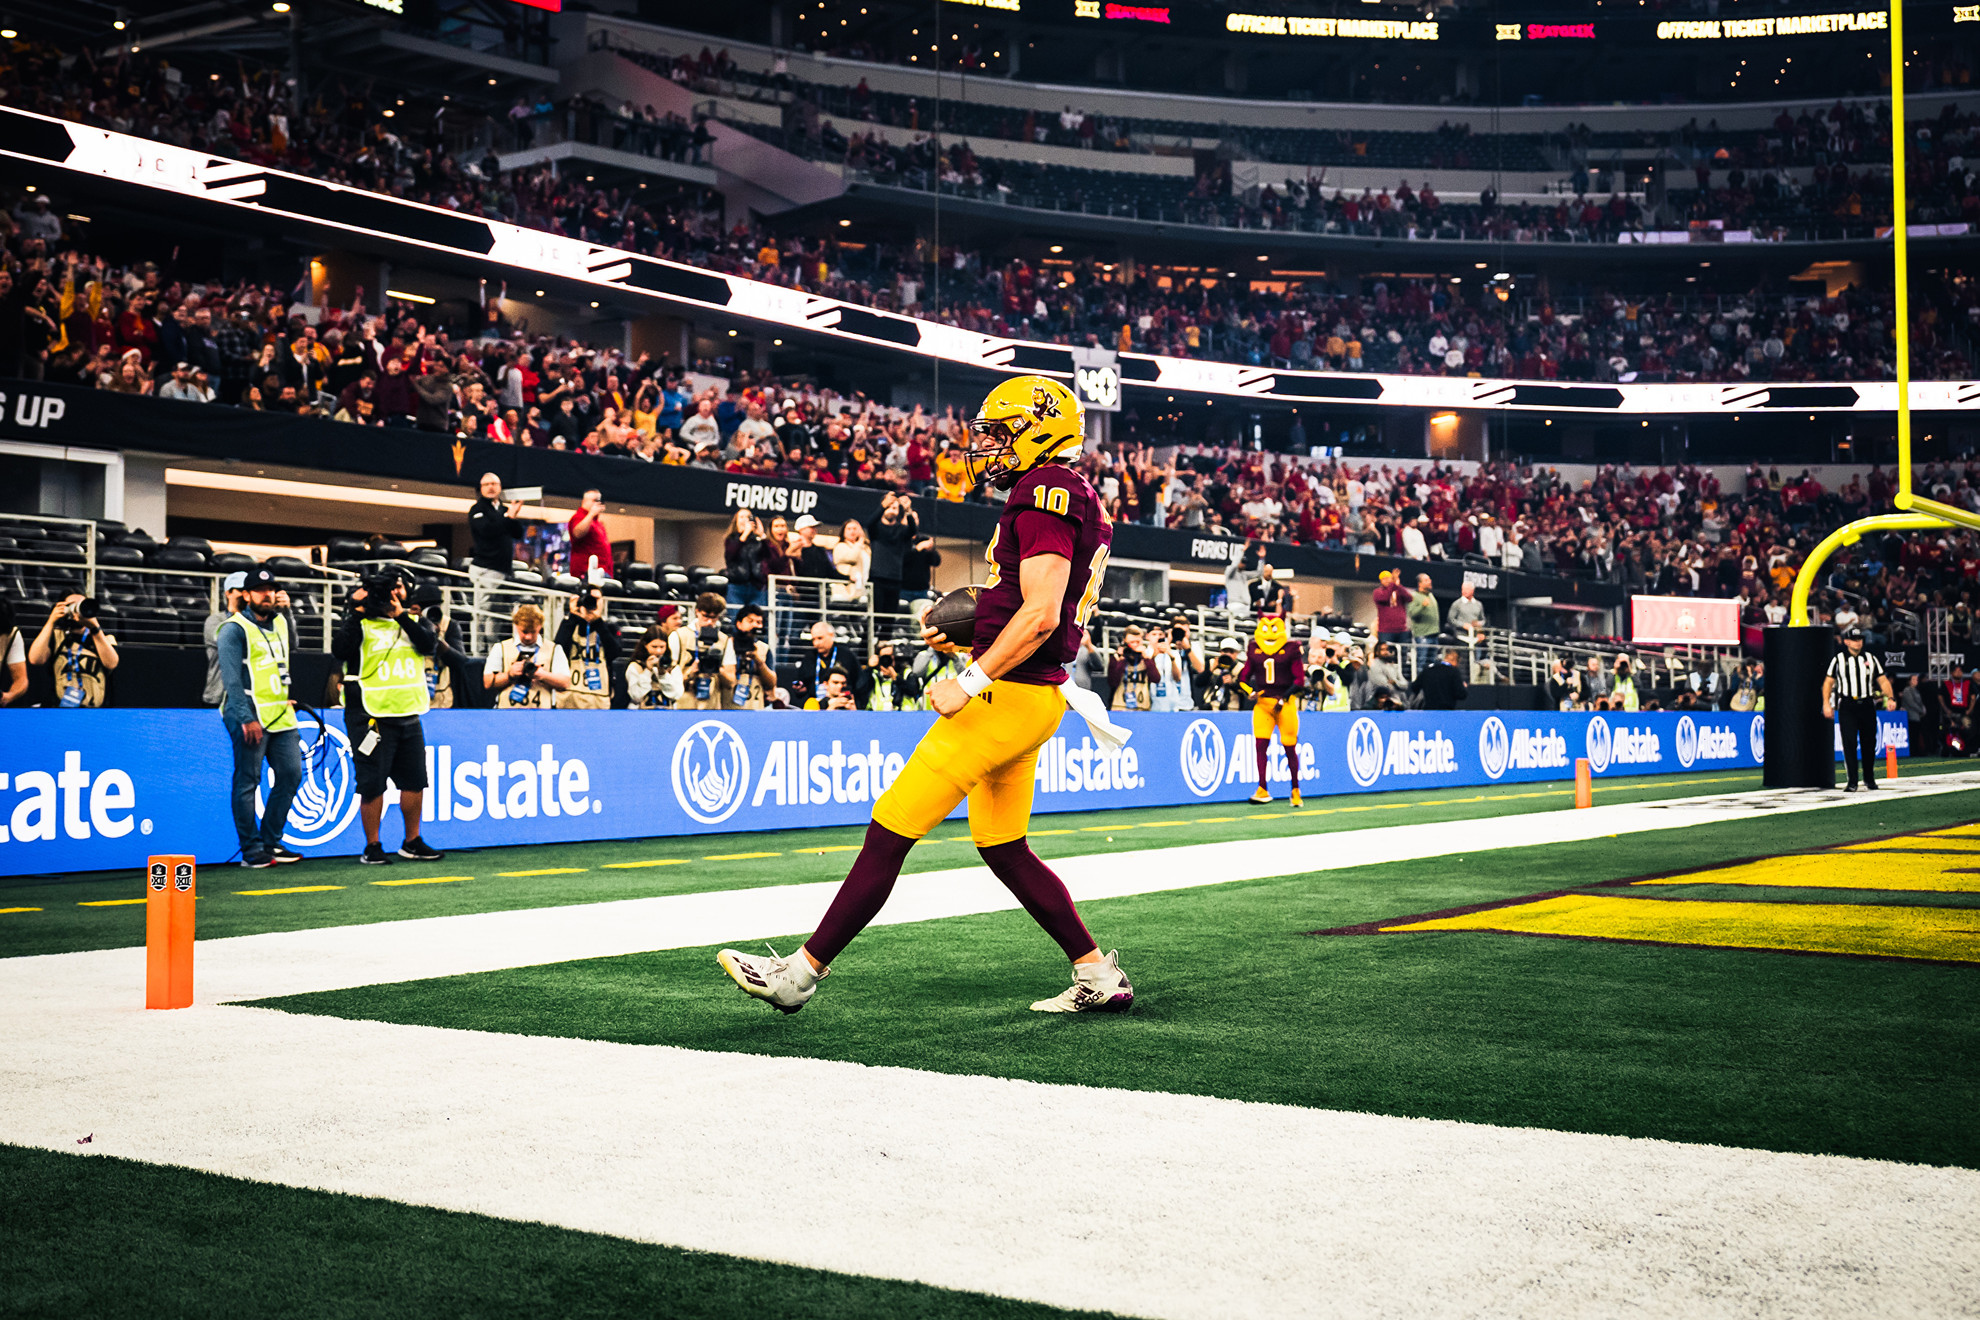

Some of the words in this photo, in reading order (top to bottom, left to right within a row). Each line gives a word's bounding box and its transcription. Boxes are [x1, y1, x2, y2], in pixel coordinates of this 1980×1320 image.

[1226, 13, 1287, 35] OFFICIAL
[1287, 17, 1337, 36] TICKET
[1337, 19, 1439, 40] MARKETPLACE
[1657, 21, 1721, 39] OFFICIAL
[1722, 18, 1775, 38] TICKET
[1777, 11, 1888, 35] MARKETPLACE
[15, 394, 66, 428] UP
[725, 482, 789, 512] FORKS
[791, 489, 818, 514] UP
[1033, 484, 1070, 516] 10
[1191, 538, 1228, 560] FORKS
[378, 658, 416, 681] 048
[1264, 658, 1275, 684] 1
[1383, 730, 1455, 776] Allstate
[1508, 728, 1567, 769] Allstate
[1610, 727, 1660, 764] Allstate
[1696, 726, 1738, 760] Allstate
[751, 740, 905, 807] Allstate
[0, 750, 136, 843] ate
